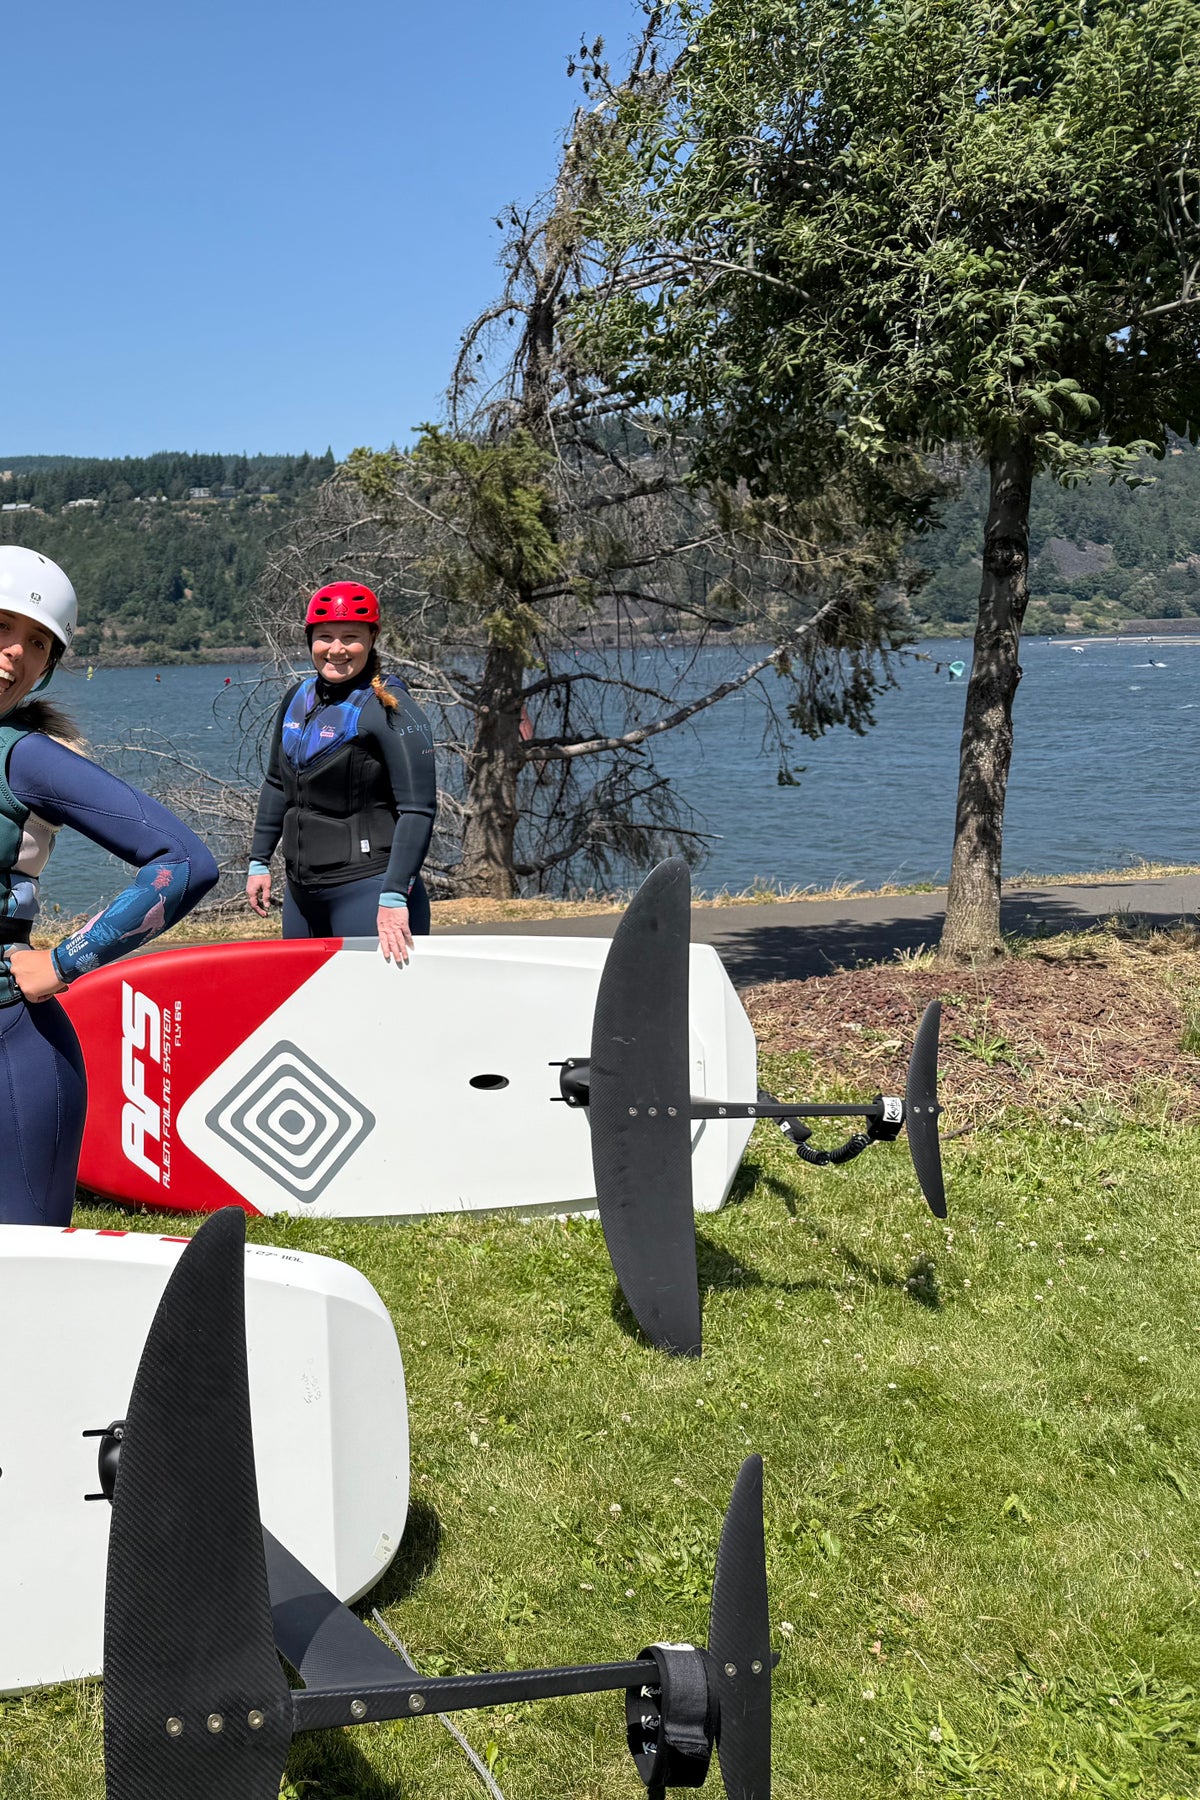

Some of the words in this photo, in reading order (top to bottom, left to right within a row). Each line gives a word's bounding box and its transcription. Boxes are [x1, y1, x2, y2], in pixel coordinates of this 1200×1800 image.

[162, 1007, 172, 1075] SYSTEM
[174, 1023, 182, 1047] FLY
[122, 980, 161, 1184] AFS
[162, 1077, 172, 1139] FOILING
[162, 1141, 171, 1189] ALIEN
